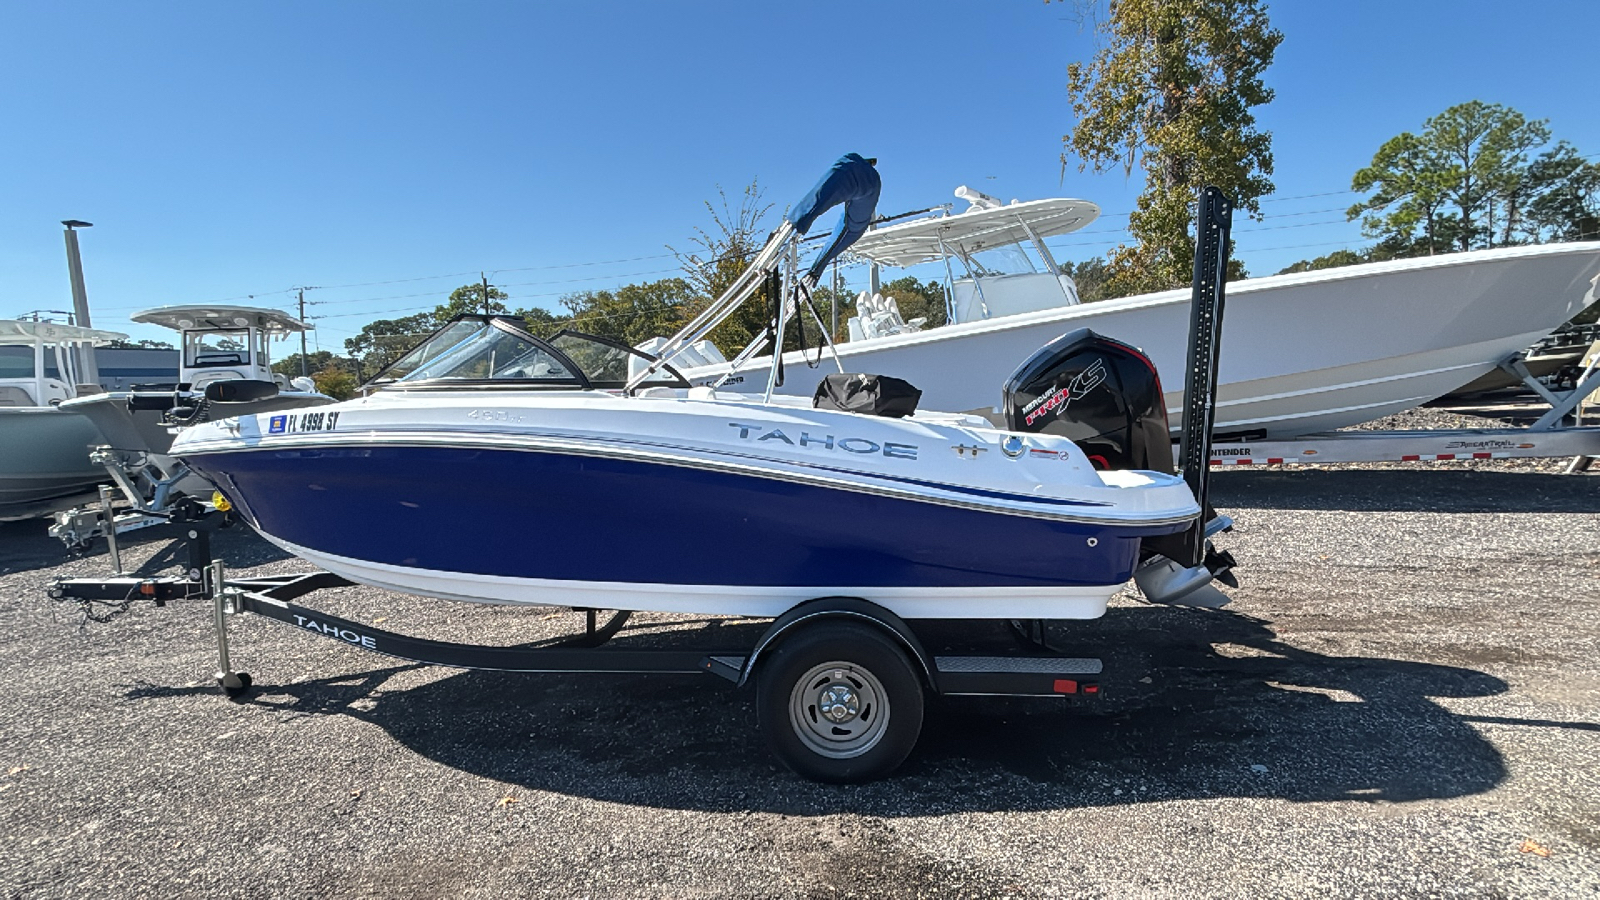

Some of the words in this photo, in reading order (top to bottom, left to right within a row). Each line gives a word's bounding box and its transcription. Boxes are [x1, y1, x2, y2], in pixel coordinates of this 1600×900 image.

[1022, 385, 1057, 415] MERCURY
[1025, 388, 1070, 426] PRO
[287, 414, 297, 433] FL
[300, 412, 326, 432] 4998
[326, 411, 341, 431] SY
[728, 422, 919, 461] TAHOE
[1211, 448, 1251, 456] NTENDER
[292, 614, 377, 650] TAHOE
